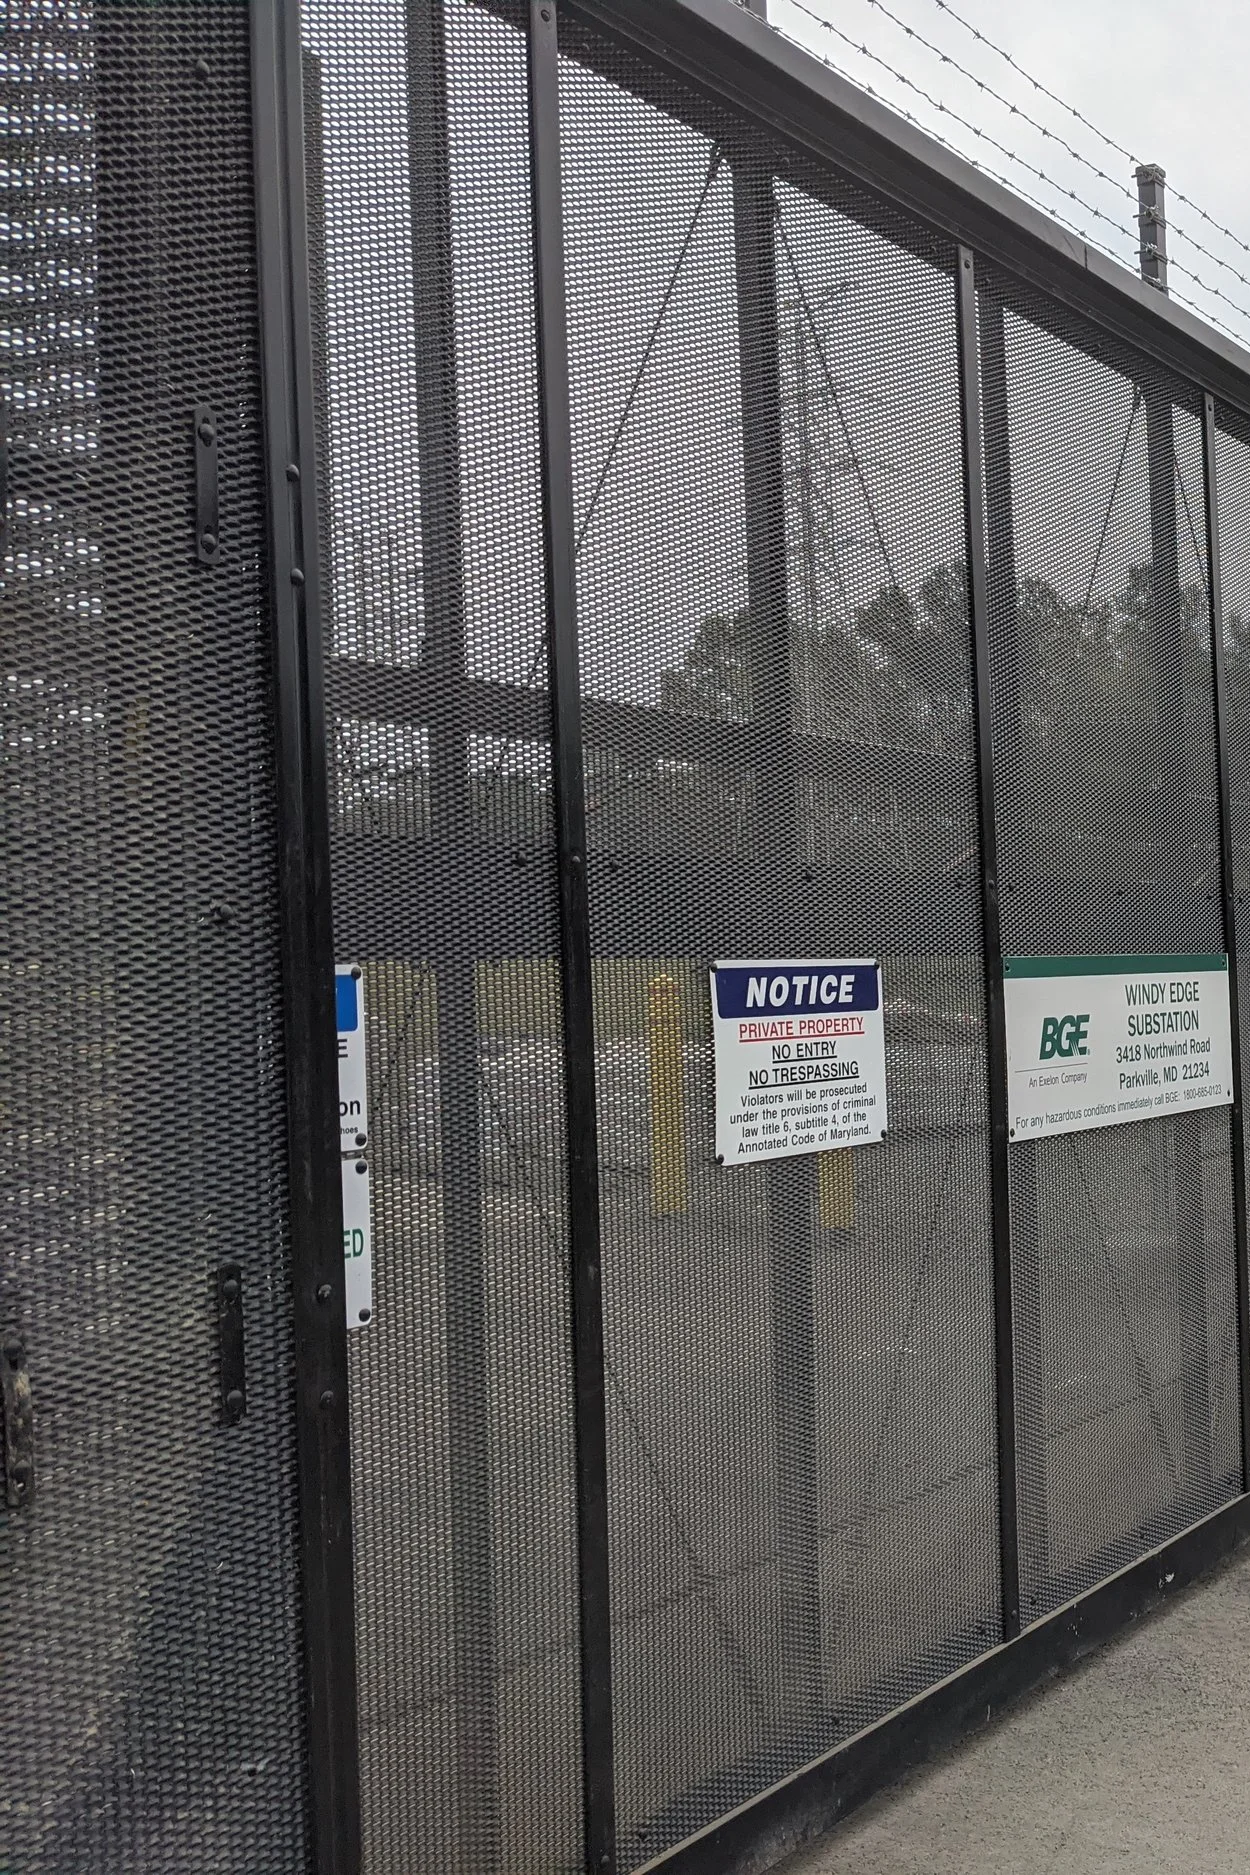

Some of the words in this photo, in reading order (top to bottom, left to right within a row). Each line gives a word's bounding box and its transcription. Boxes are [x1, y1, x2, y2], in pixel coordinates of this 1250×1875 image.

[746, 974, 855, 1008] NOTICE
[1125, 983, 1166, 1006] WINDY
[1170, 981, 1200, 1003] EDGE
[739, 1020, 794, 1039] PRIVATE
[799, 1017, 864, 1035] PROPERTY
[1039, 1014, 1091, 1060] BGE
[1128, 1010, 1199, 1037] SUBSTATION
[772, 1044, 791, 1060] NO
[797, 1041, 837, 1058] ENTRY
[1116, 1045, 1142, 1064] 3418
[1143, 1040, 1187, 1060] Northwind
[1190, 1037, 1211, 1054] Road
[749, 1069, 768, 1086] NO
[772, 1061, 859, 1083] TRESPASSING
[1029, 1077, 1038, 1088] An
[1039, 1075, 1060, 1087] Exelon
[1061, 1072, 1088, 1086] Company
[1119, 1069, 1162, 1090] Parkville,
[1163, 1065, 1178, 1082] MD
[1182, 1061, 1210, 1081] 21234
[741, 1092, 784, 1108] Violators
[787, 1089, 802, 1102] will
[805, 1087, 817, 1100] be
[819, 1082, 867, 1102] prosecuted
[1015, 1116, 1029, 1130] For
[1031, 1116, 1044, 1129] any
[1045, 1110, 1082, 1124] hazardous
[1083, 1103, 1116, 1118] conditions
[1117, 1096, 1154, 1112] immediately
[1154, 1094, 1164, 1106] call
[1165, 1091, 1180, 1104] BGE:
[1183, 1084, 1222, 1101] 1800-685-0123
[730, 1111, 758, 1125] under
[762, 1107, 778, 1121] the
[781, 1103, 829, 1121] provisions
[831, 1100, 841, 1112] of
[842, 1095, 876, 1111] criminal
[742, 1126, 758, 1138] law
[762, 1121, 780, 1136] title
[783, 1121, 792, 1134] 6,
[795, 1117, 829, 1131] subtitle
[831, 1116, 840, 1127] 4,
[842, 1113, 851, 1125] of
[853, 1111, 867, 1123] the
[738, 1138, 788, 1155] Annotated
[791, 1132, 815, 1146] Code
[818, 1131, 828, 1142] of
[830, 1125, 872, 1141] Maryland.
